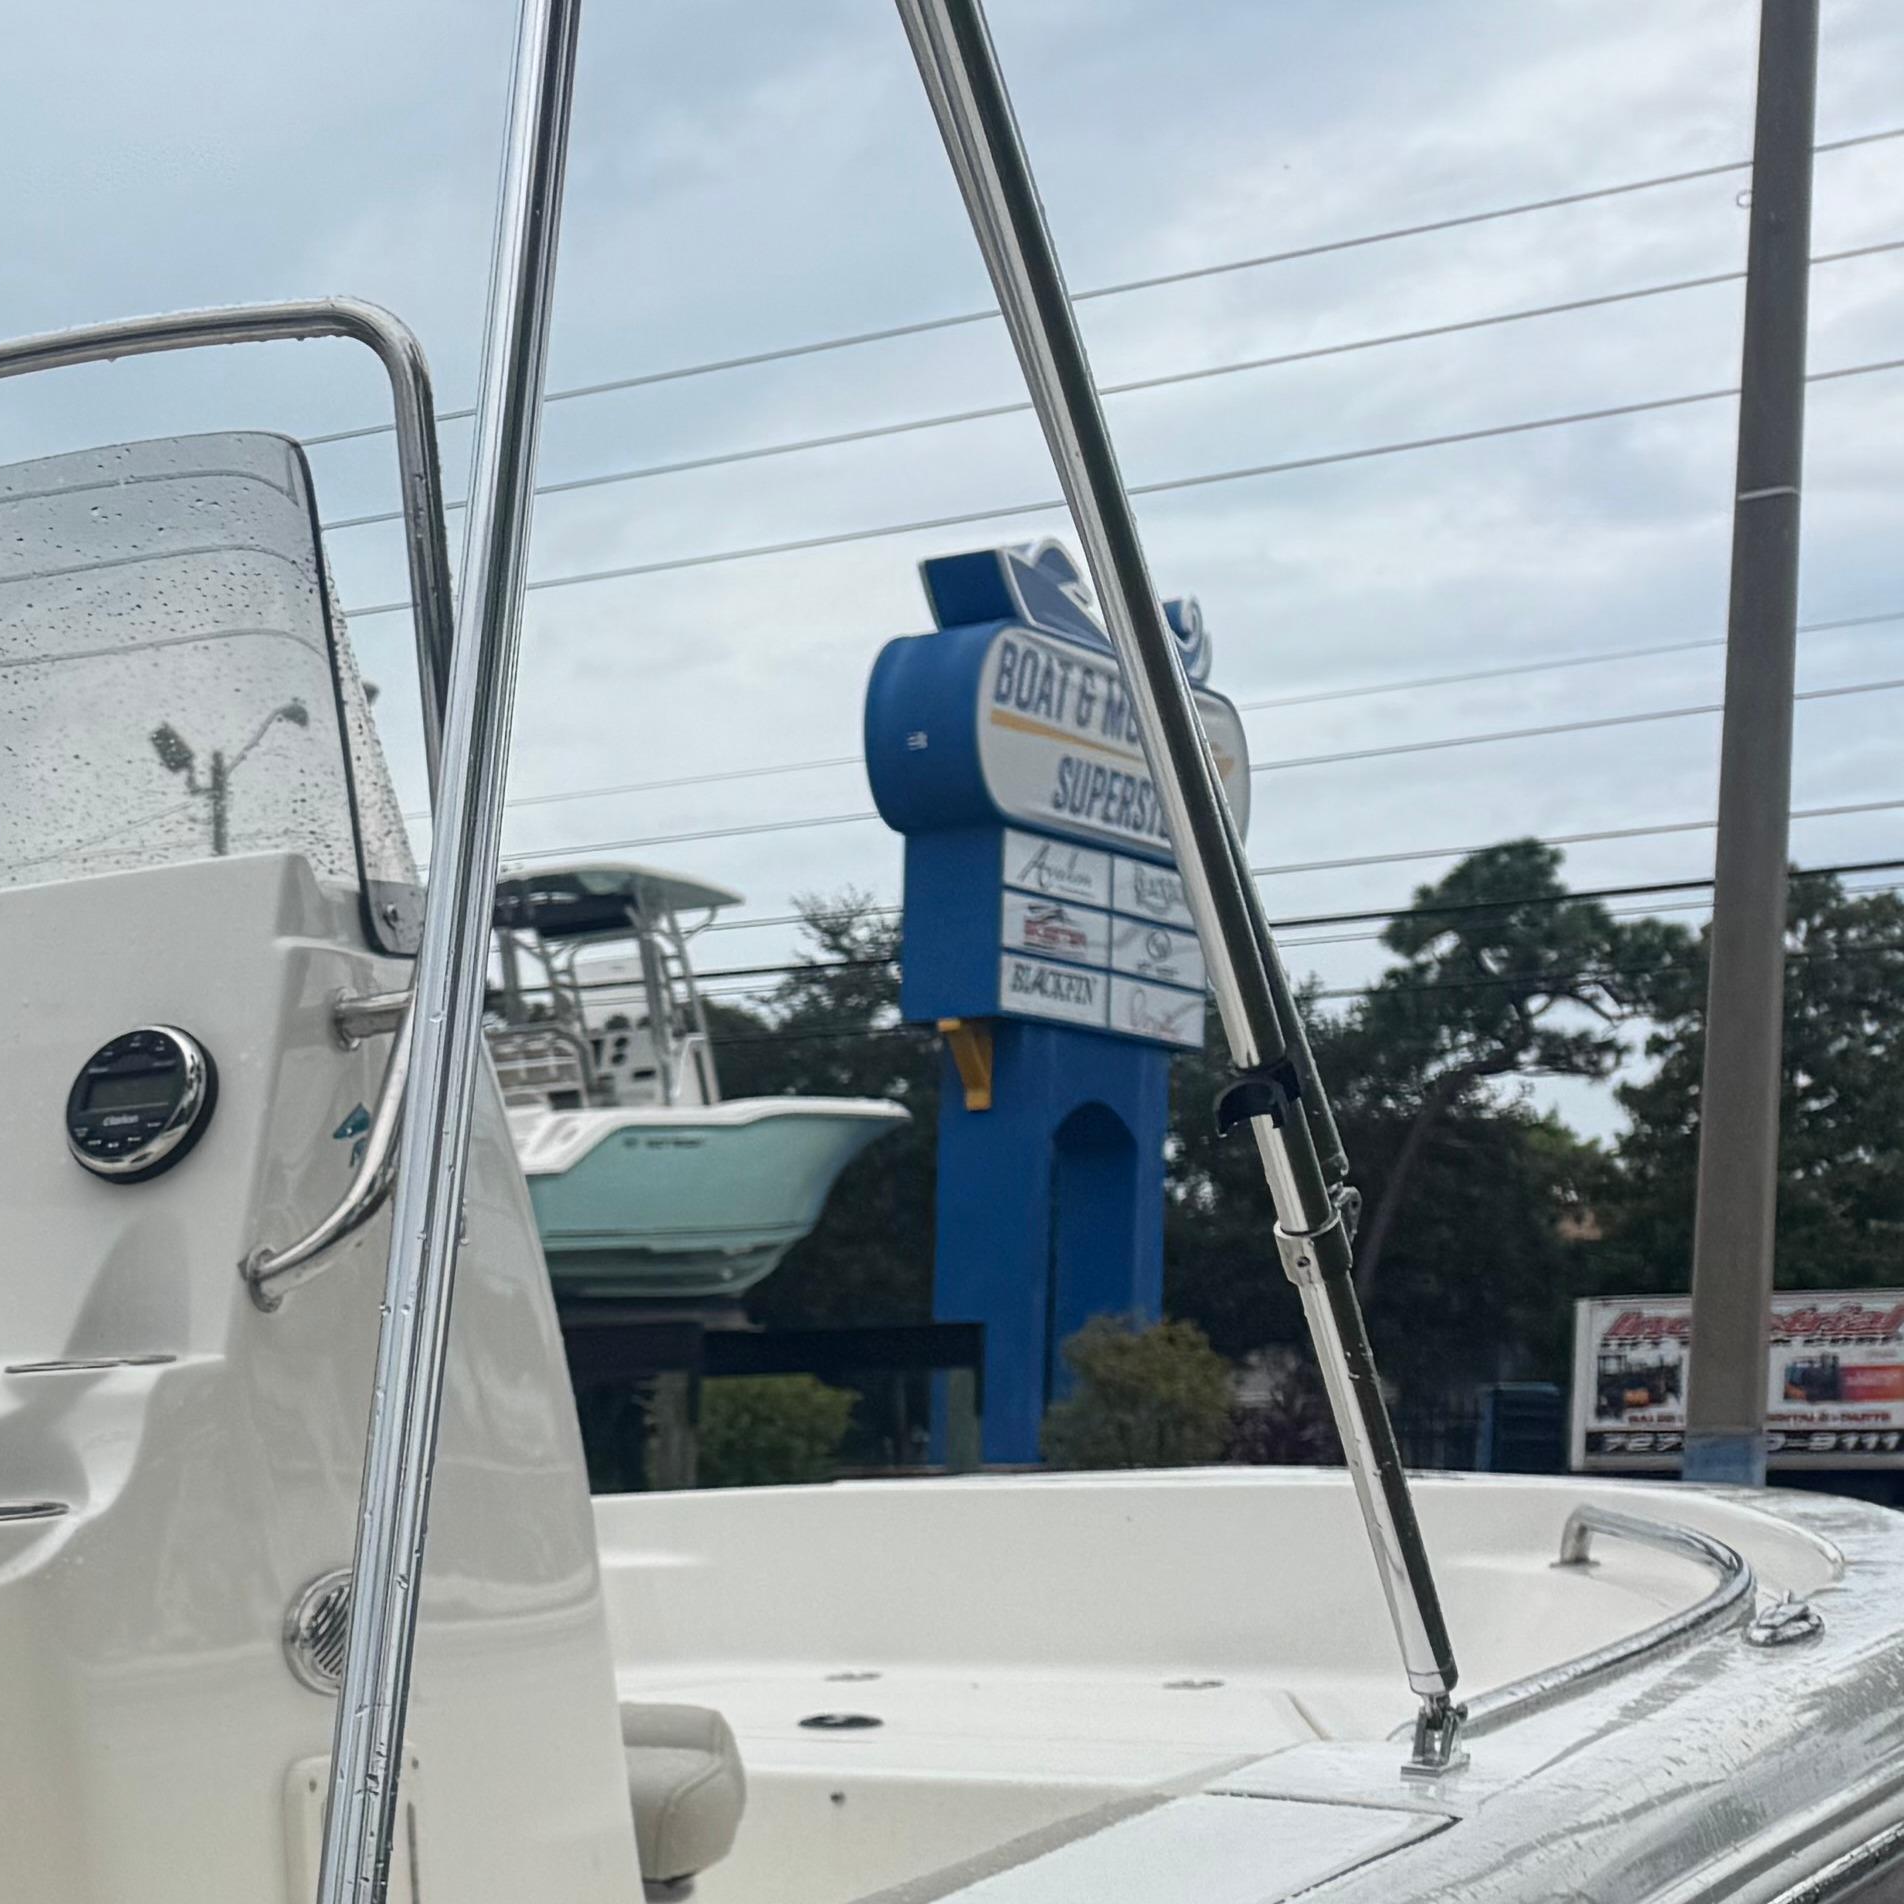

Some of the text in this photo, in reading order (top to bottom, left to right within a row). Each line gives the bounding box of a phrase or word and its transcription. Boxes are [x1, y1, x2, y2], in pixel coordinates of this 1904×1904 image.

[995, 640, 1071, 724] BOAT
[1075, 667, 1097, 728] &
[1053, 754, 1173, 838] SUPERST
[1011, 961, 1094, 1007] BLACKFIN
